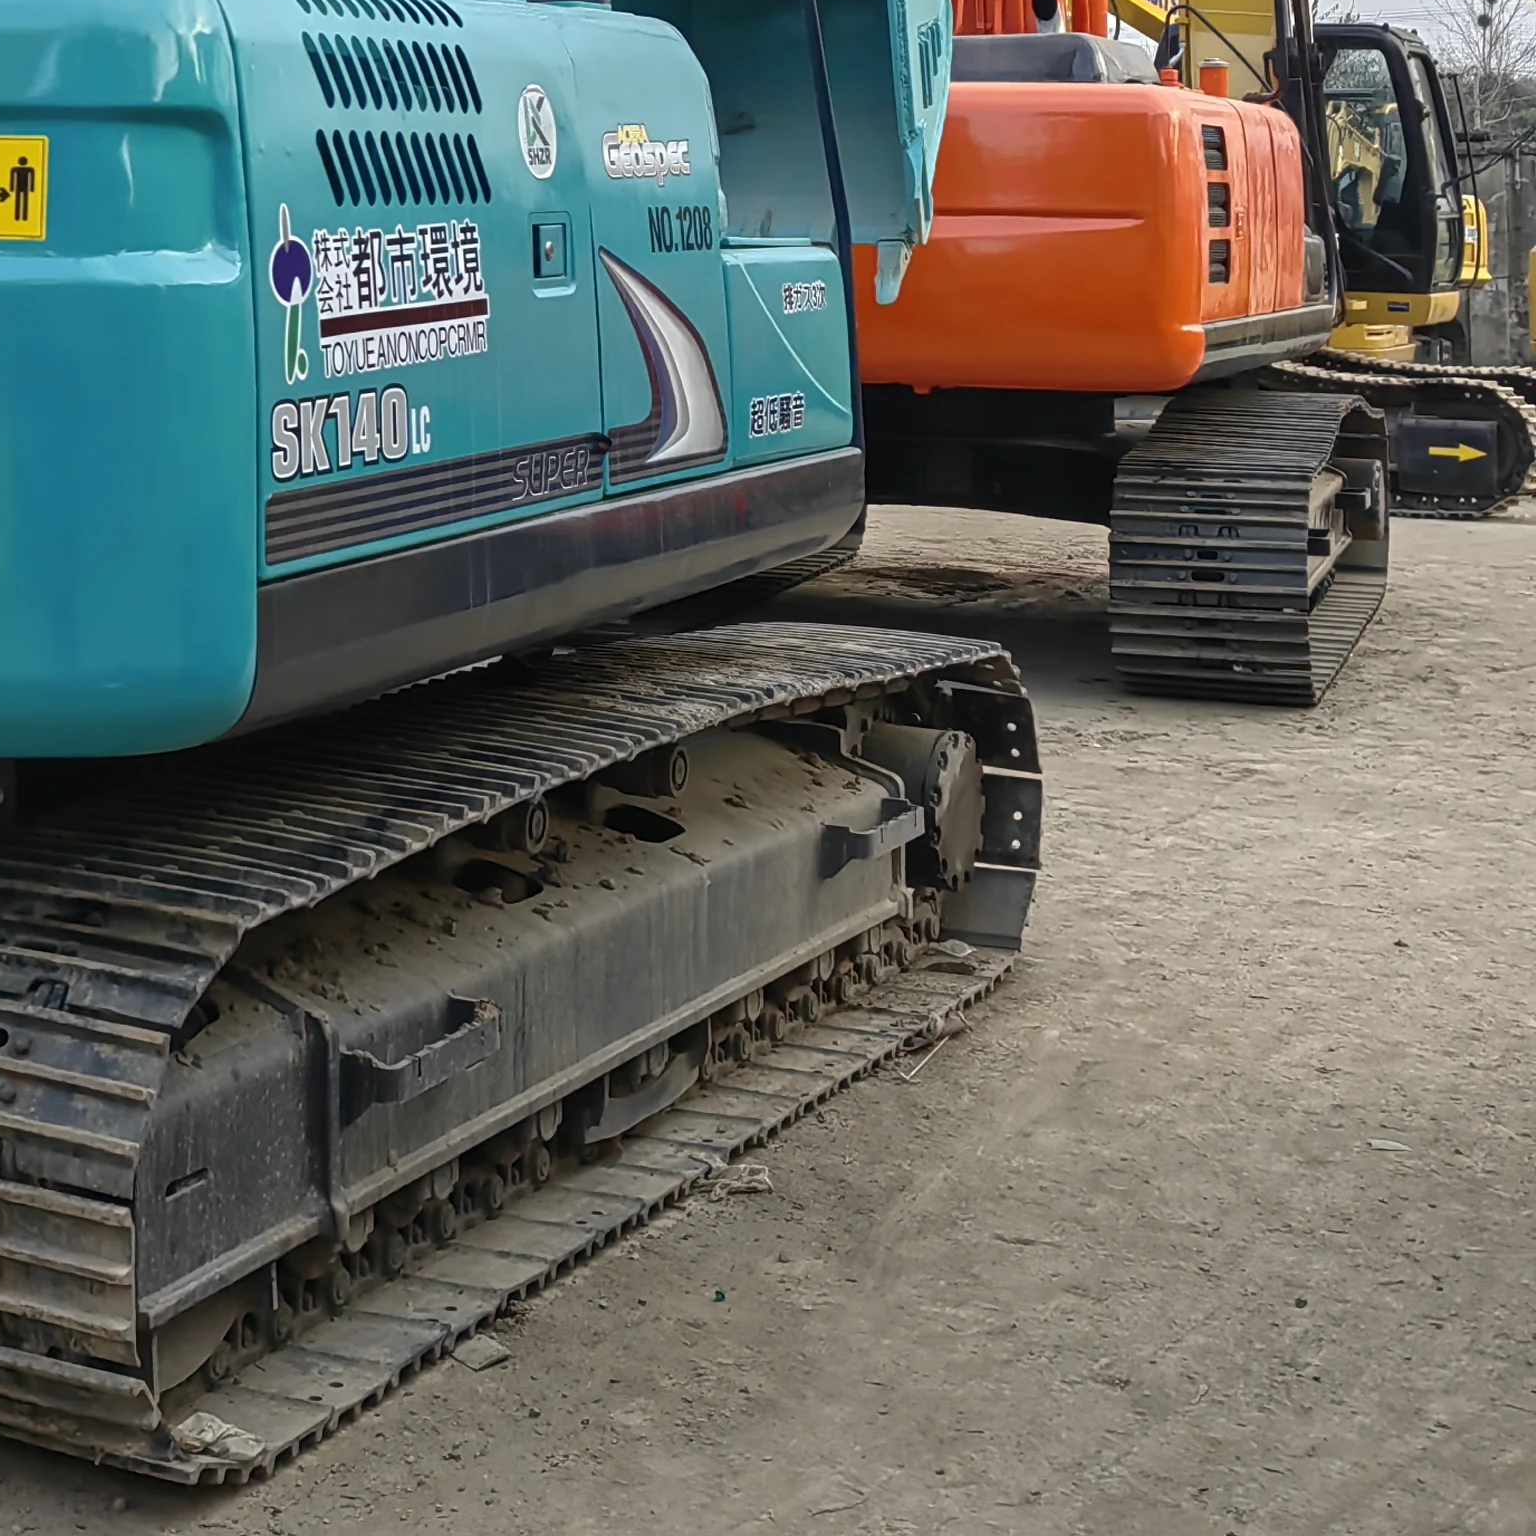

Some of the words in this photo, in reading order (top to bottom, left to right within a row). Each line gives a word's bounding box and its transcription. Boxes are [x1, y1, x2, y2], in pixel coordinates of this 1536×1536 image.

[527, 147, 552, 165] SHZR
[647, 205, 713, 253] NO.1208
[351, 221, 484, 310] 都市環境
[511, 445, 591, 502] SUPER
